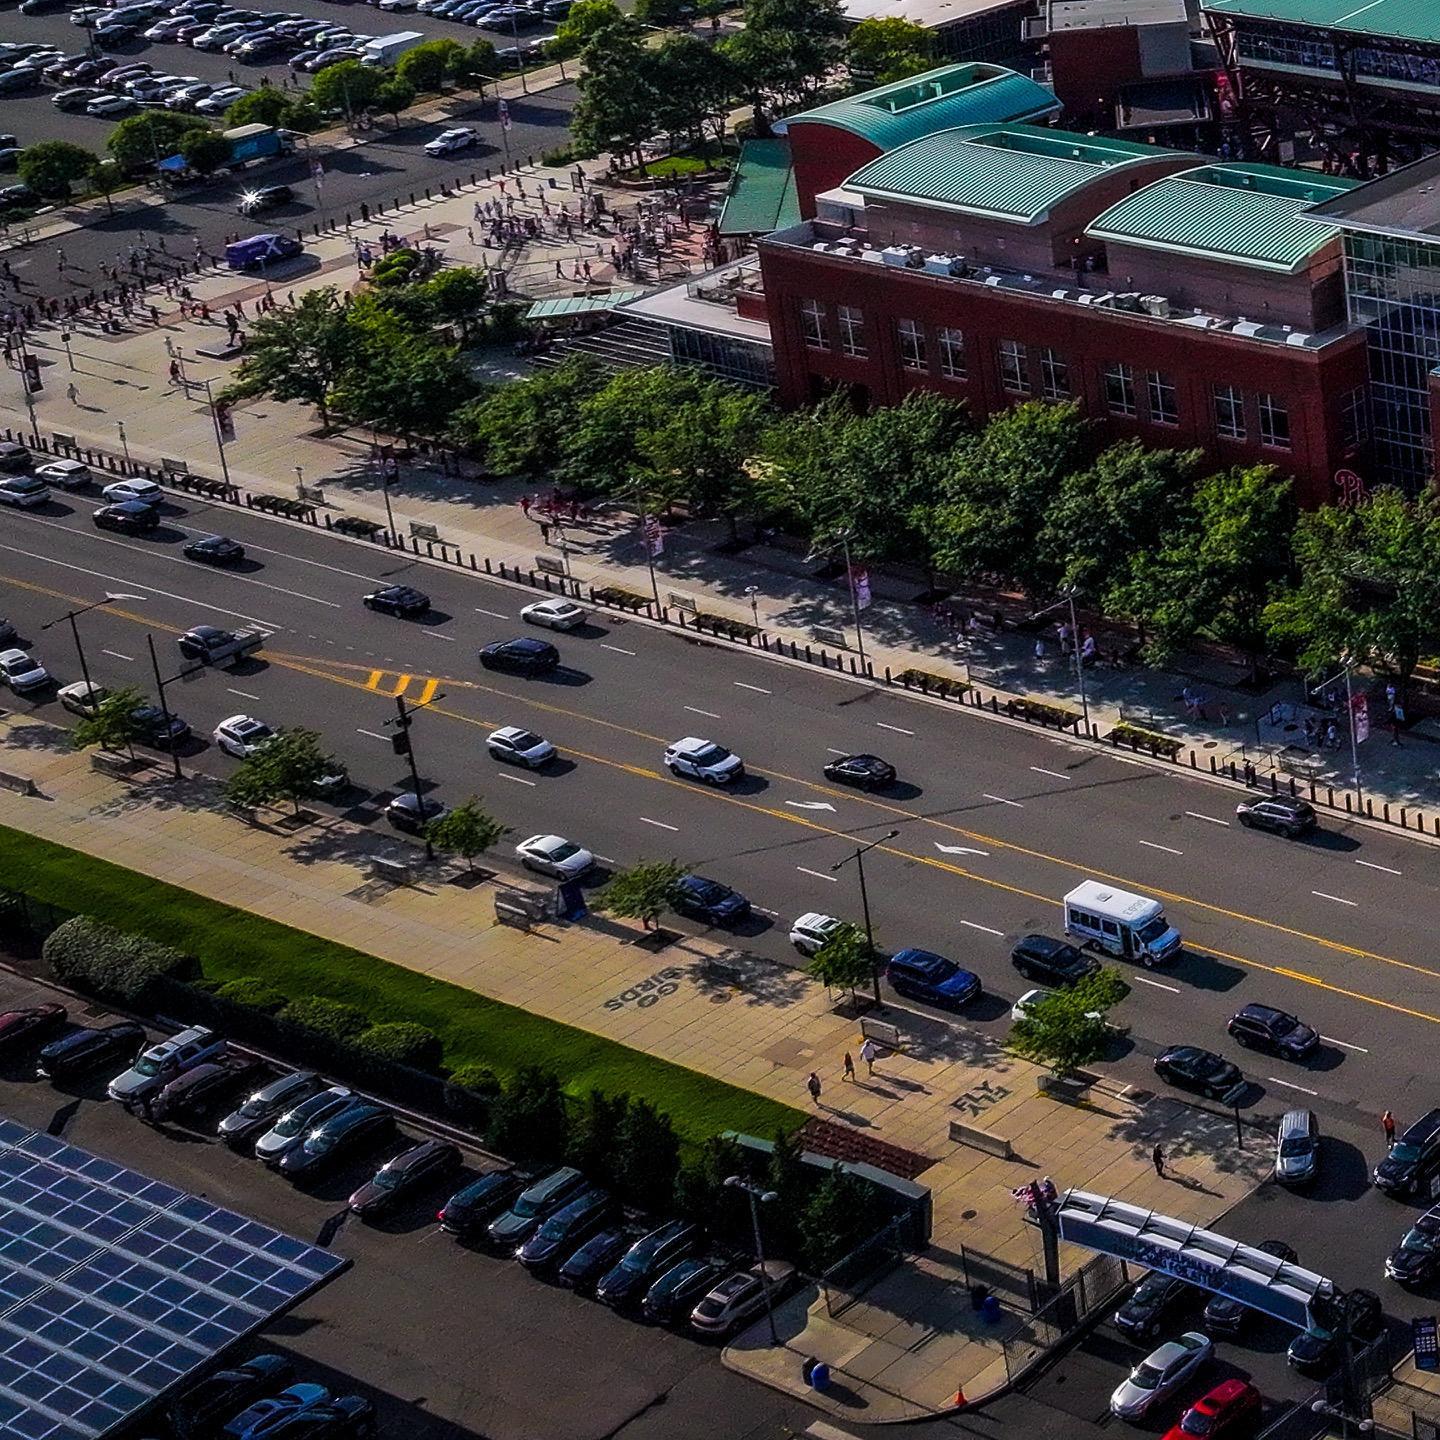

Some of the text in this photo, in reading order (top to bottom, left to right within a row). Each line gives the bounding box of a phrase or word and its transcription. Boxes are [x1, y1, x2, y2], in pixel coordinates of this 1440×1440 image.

[603, 966, 685, 1012] BIRDS
[637, 982, 679, 1008] GO
[950, 1080, 994, 1112] FLY
